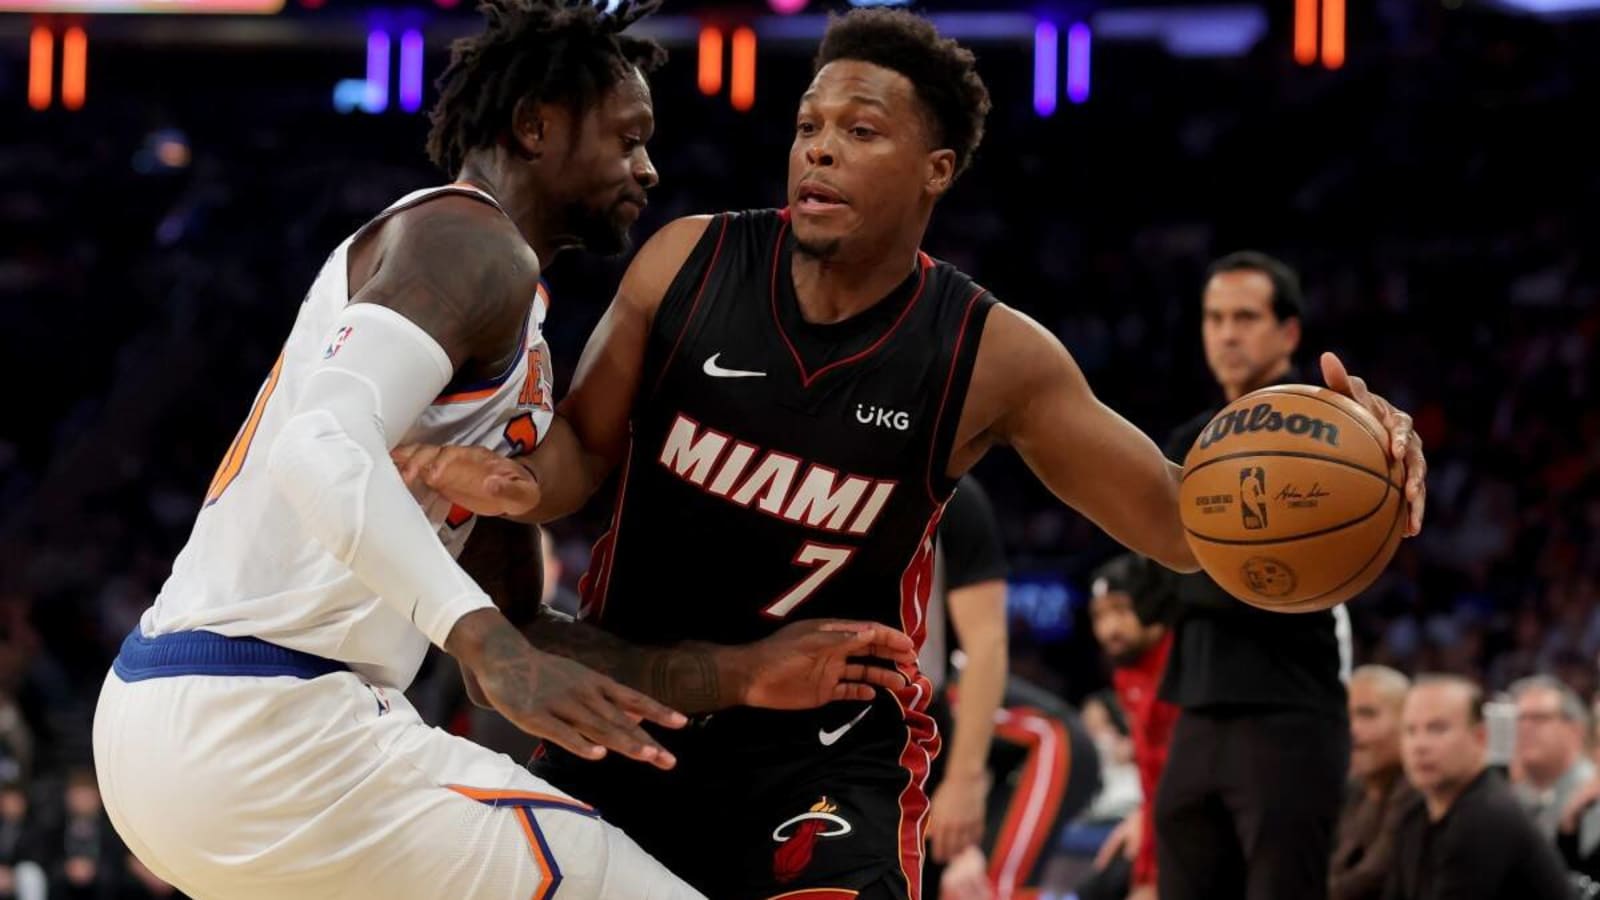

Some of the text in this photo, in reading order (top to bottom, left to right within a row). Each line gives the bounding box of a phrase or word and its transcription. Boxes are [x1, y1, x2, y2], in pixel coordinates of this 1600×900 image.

[1200, 403, 1339, 449] Wilson
[658, 412, 898, 535] MIAMI
[762, 541, 855, 618] 7
